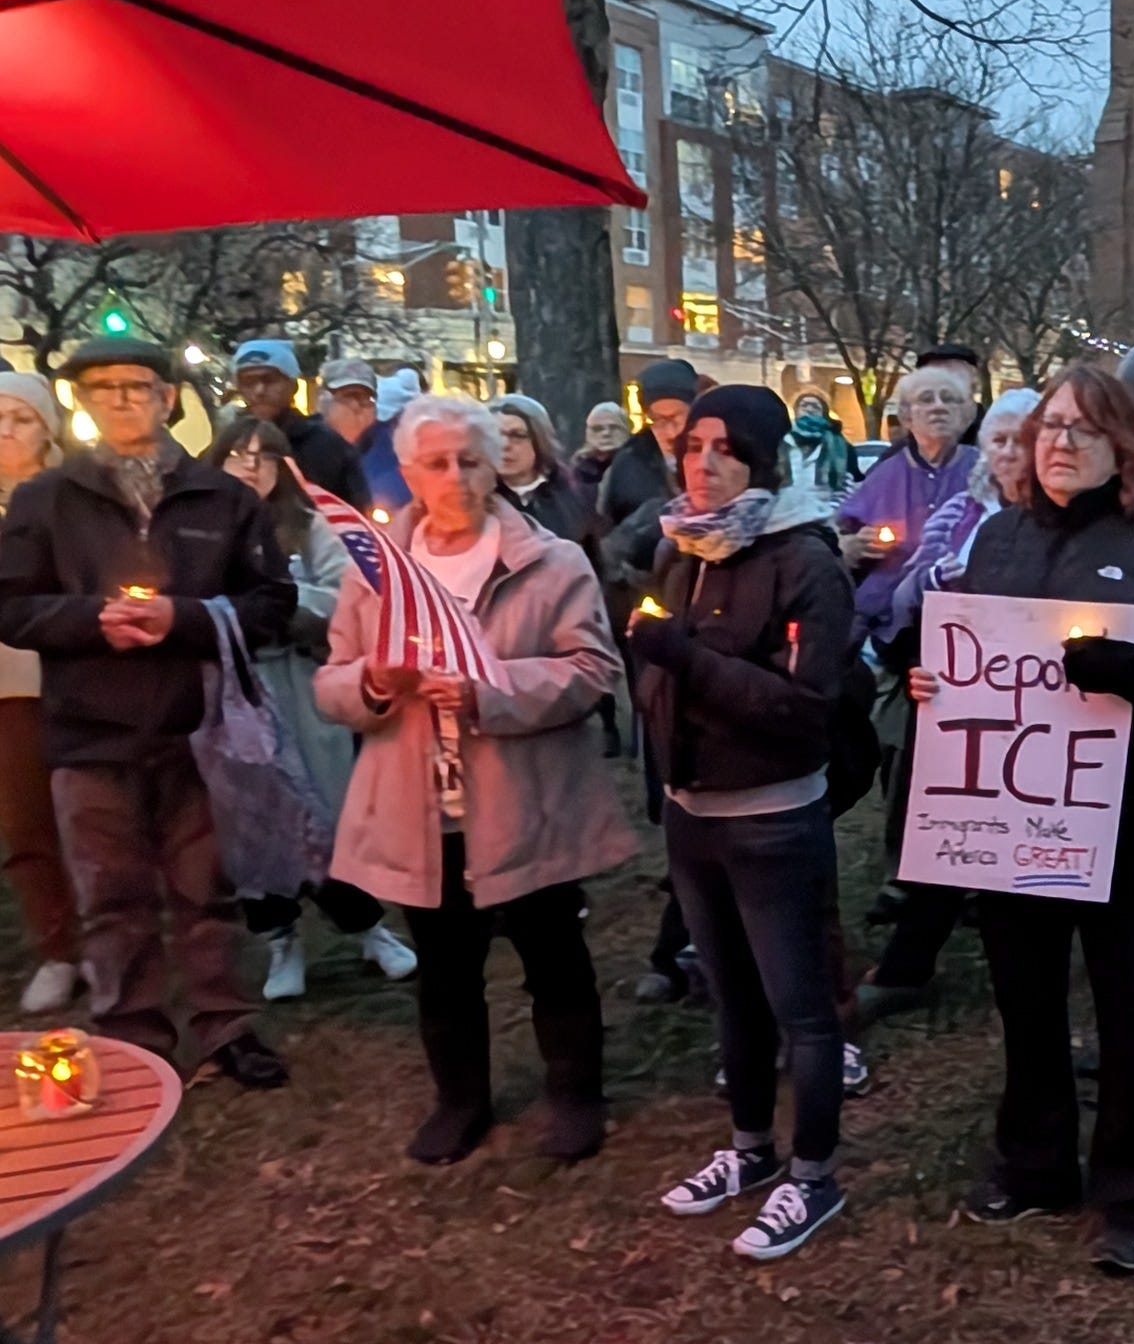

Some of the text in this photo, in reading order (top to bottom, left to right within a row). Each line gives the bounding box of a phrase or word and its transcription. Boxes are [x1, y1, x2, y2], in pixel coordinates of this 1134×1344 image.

[938, 623, 1087, 725] Depo
[925, 718, 1117, 809] ICE
[1013, 844, 1097, 877] GREAT!
